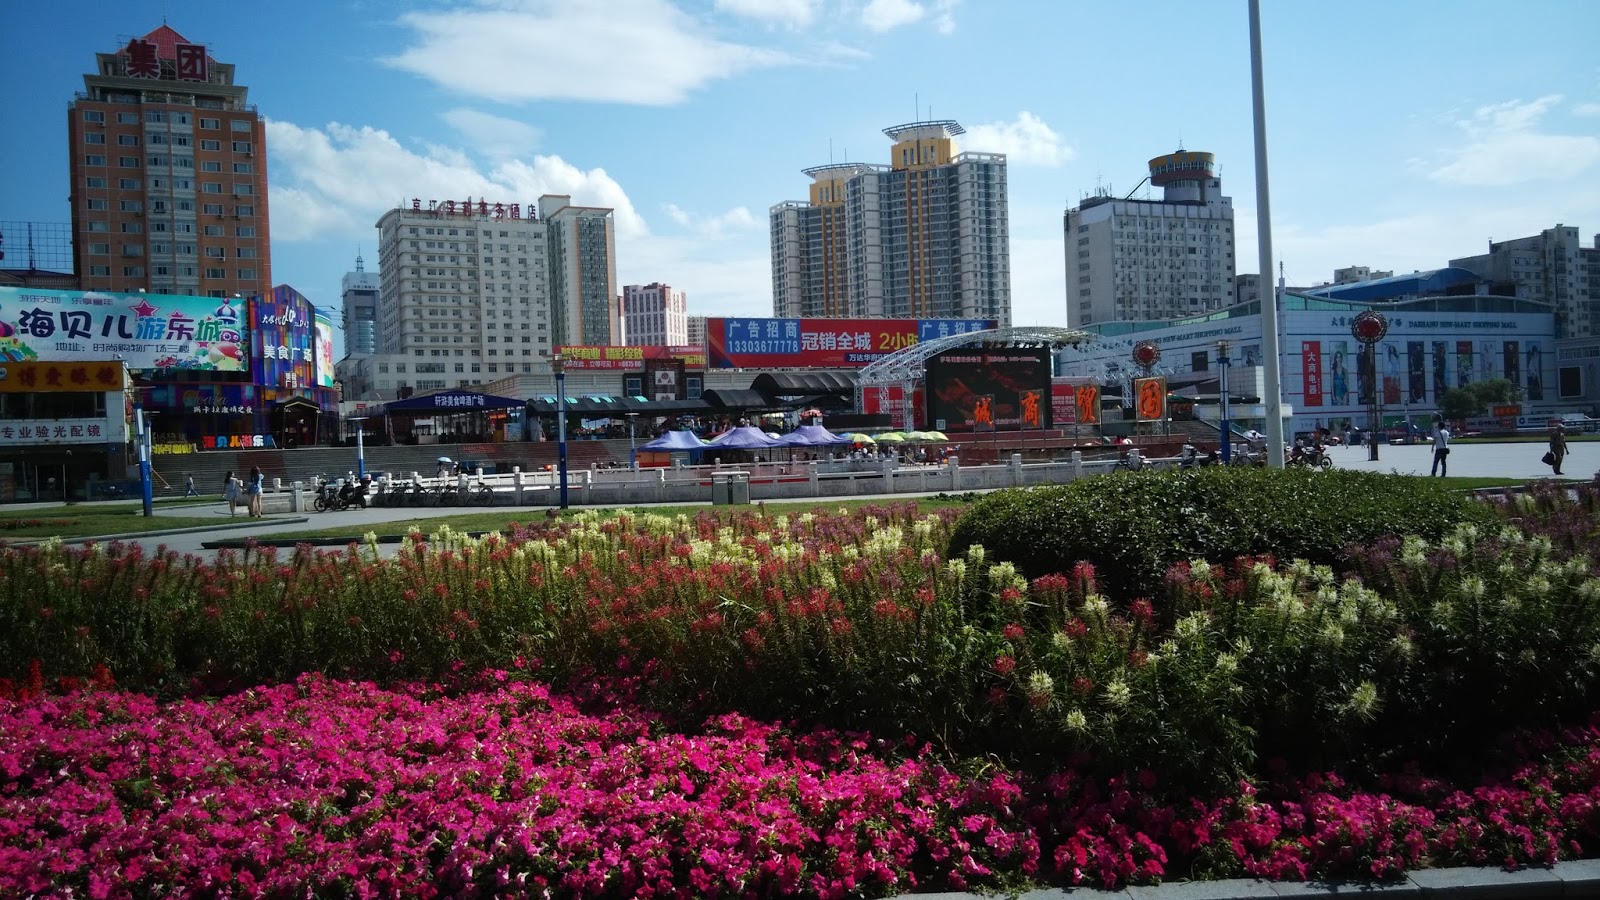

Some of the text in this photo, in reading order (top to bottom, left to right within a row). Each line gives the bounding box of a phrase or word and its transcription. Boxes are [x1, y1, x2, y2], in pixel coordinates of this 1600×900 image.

[125, 38, 208, 82] 集团
[19, 294, 61, 304] 游乐天地
[18, 307, 223, 342] 海贝儿游乐城
[728, 321, 798, 338] 广告招商
[1224, 325, 1243, 335] MALL
[1501, 320, 1517, 329] MALL
[728, 340, 799, 353] 13303677778
[801, 332, 871, 351] 冠销全城
[263, 344, 312, 363] 美食广场
[1307, 351, 1317, 395] 大商电器
[1, 425, 101, 439] 专业验光配镜
